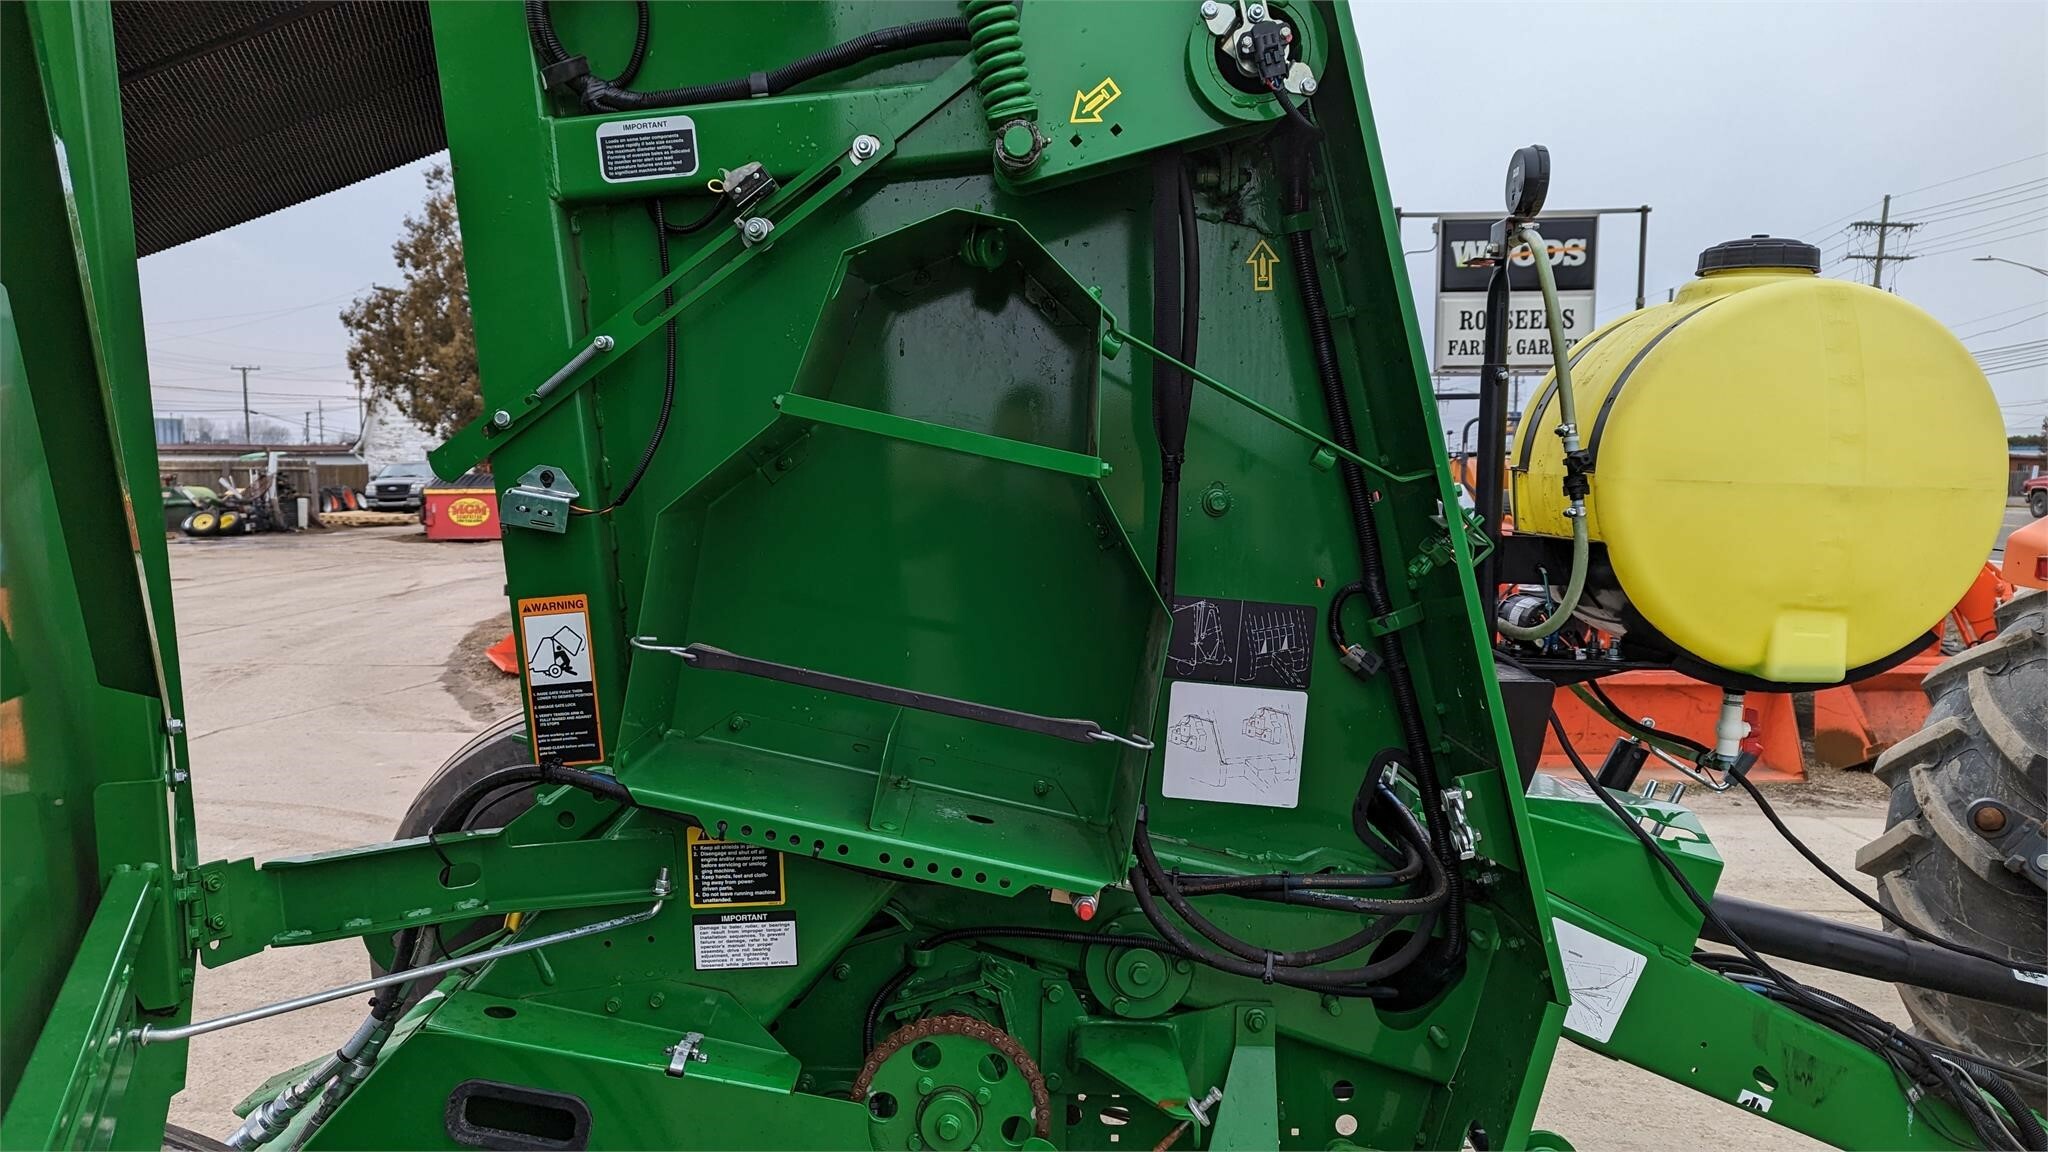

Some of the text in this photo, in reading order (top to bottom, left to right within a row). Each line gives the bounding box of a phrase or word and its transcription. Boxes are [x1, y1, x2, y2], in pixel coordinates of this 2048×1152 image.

[623, 121, 667, 130] IMPORTANT
[1451, 239, 1586, 267] WODS
[1448, 340, 1484, 356] FAR
[531, 600, 584, 612] WARNING
[721, 914, 768, 922] IMPORTANT
